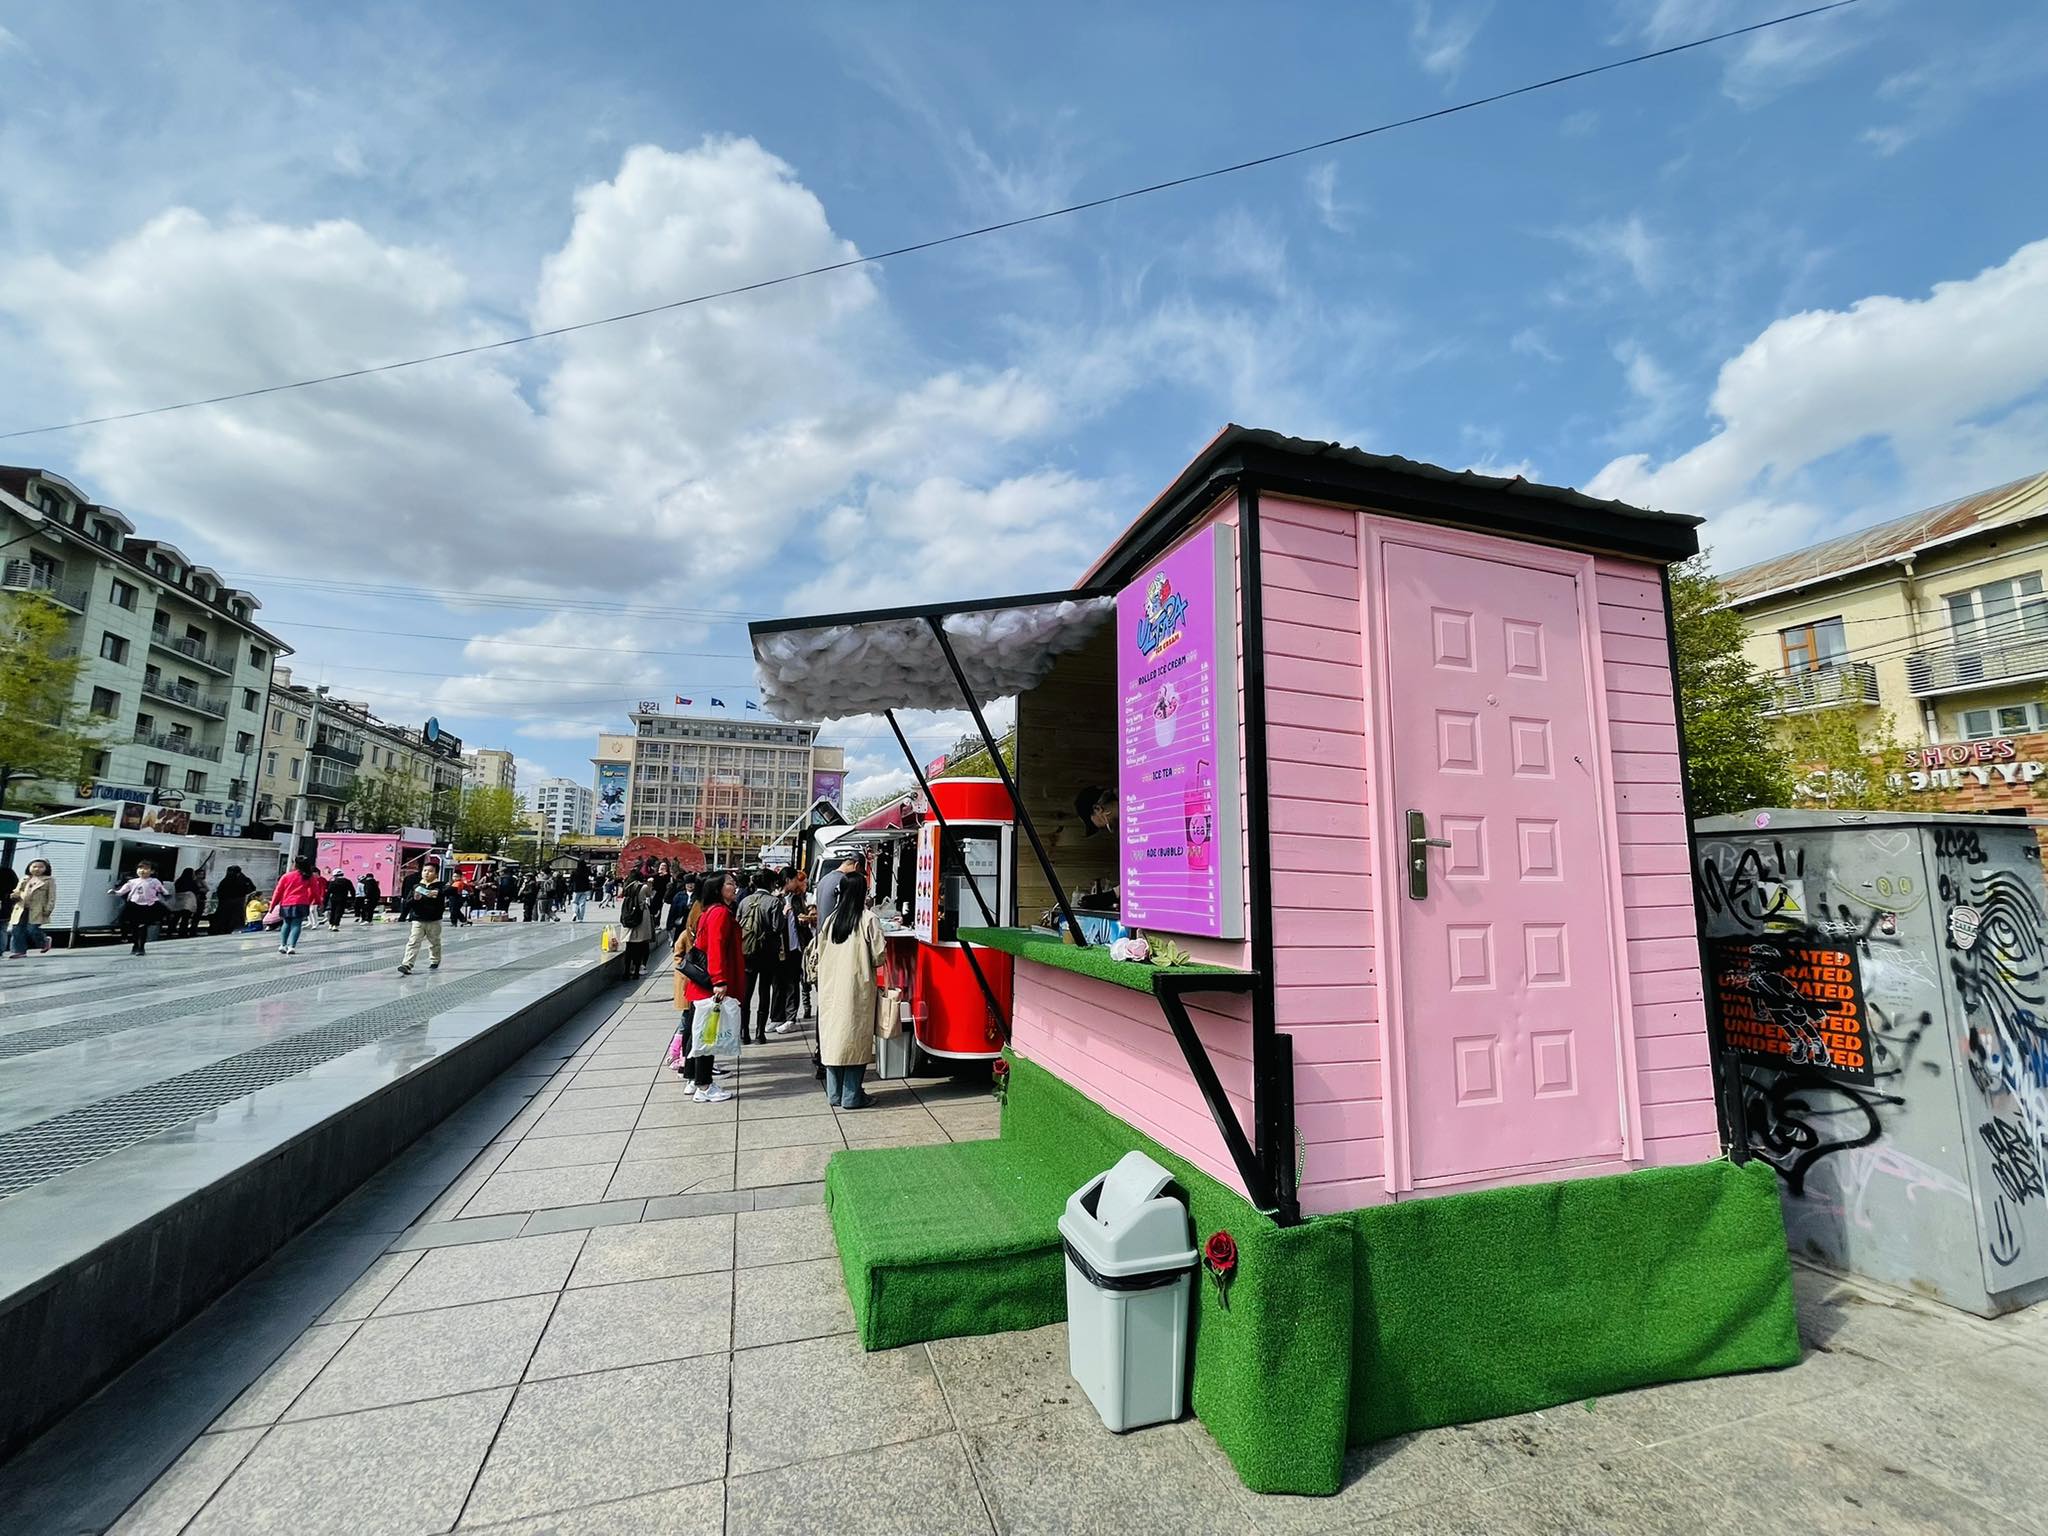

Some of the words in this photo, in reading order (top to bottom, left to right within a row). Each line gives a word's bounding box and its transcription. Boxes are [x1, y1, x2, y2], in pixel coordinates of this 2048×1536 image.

[1138, 669, 1157, 685] ROLLED
[1158, 664, 1167, 676] ICE
[1167, 655, 1187, 671] CREAM
[1905, 740, 2014, 769] SHOES
[1152, 769, 1162, 780] ICE
[1162, 767, 1173, 778] TEA
[1192, 825, 1205, 836] tea
[1147, 848, 1157, 857] ADE
